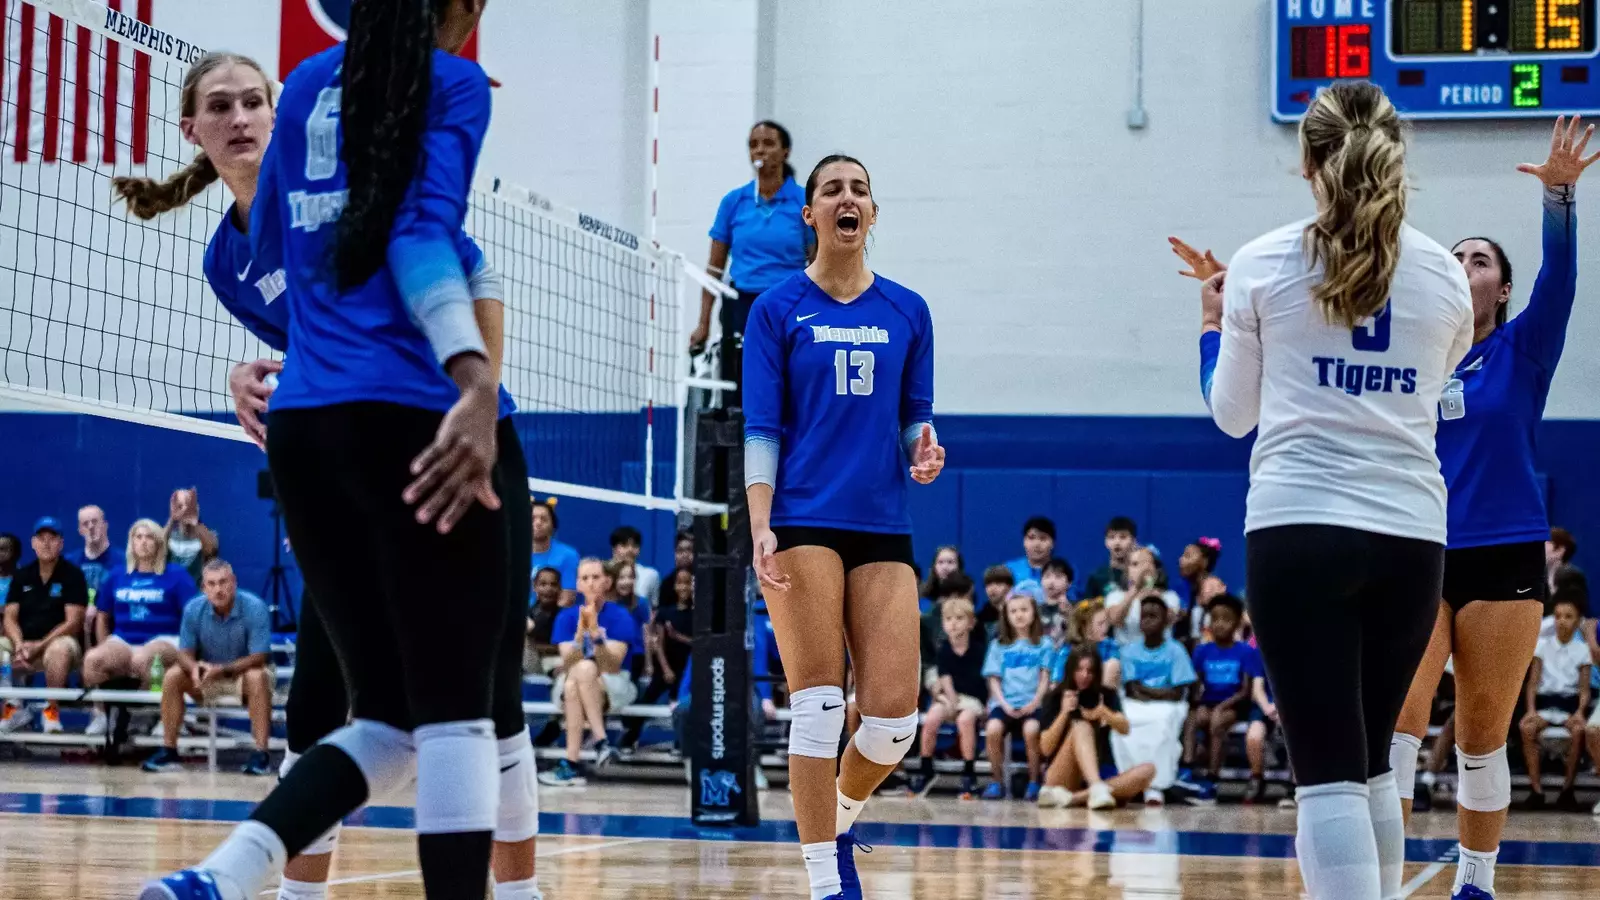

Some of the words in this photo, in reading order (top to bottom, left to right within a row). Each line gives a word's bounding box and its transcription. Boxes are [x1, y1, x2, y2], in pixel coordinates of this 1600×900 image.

[104, 7, 174, 56] MEMPHIS
[1287, 0, 1375, 19] HOME
[1326, 24, 1370, 77] 16
[1440, 84, 1503, 105] PERIOD
[1513, 63, 1539, 106] 2
[809, 325, 890, 345] Memphis
[834, 349, 875, 396] 13
[1312, 357, 1417, 396] Tigers
[709, 656, 726, 702] sports
[709, 703, 726, 760] imports
